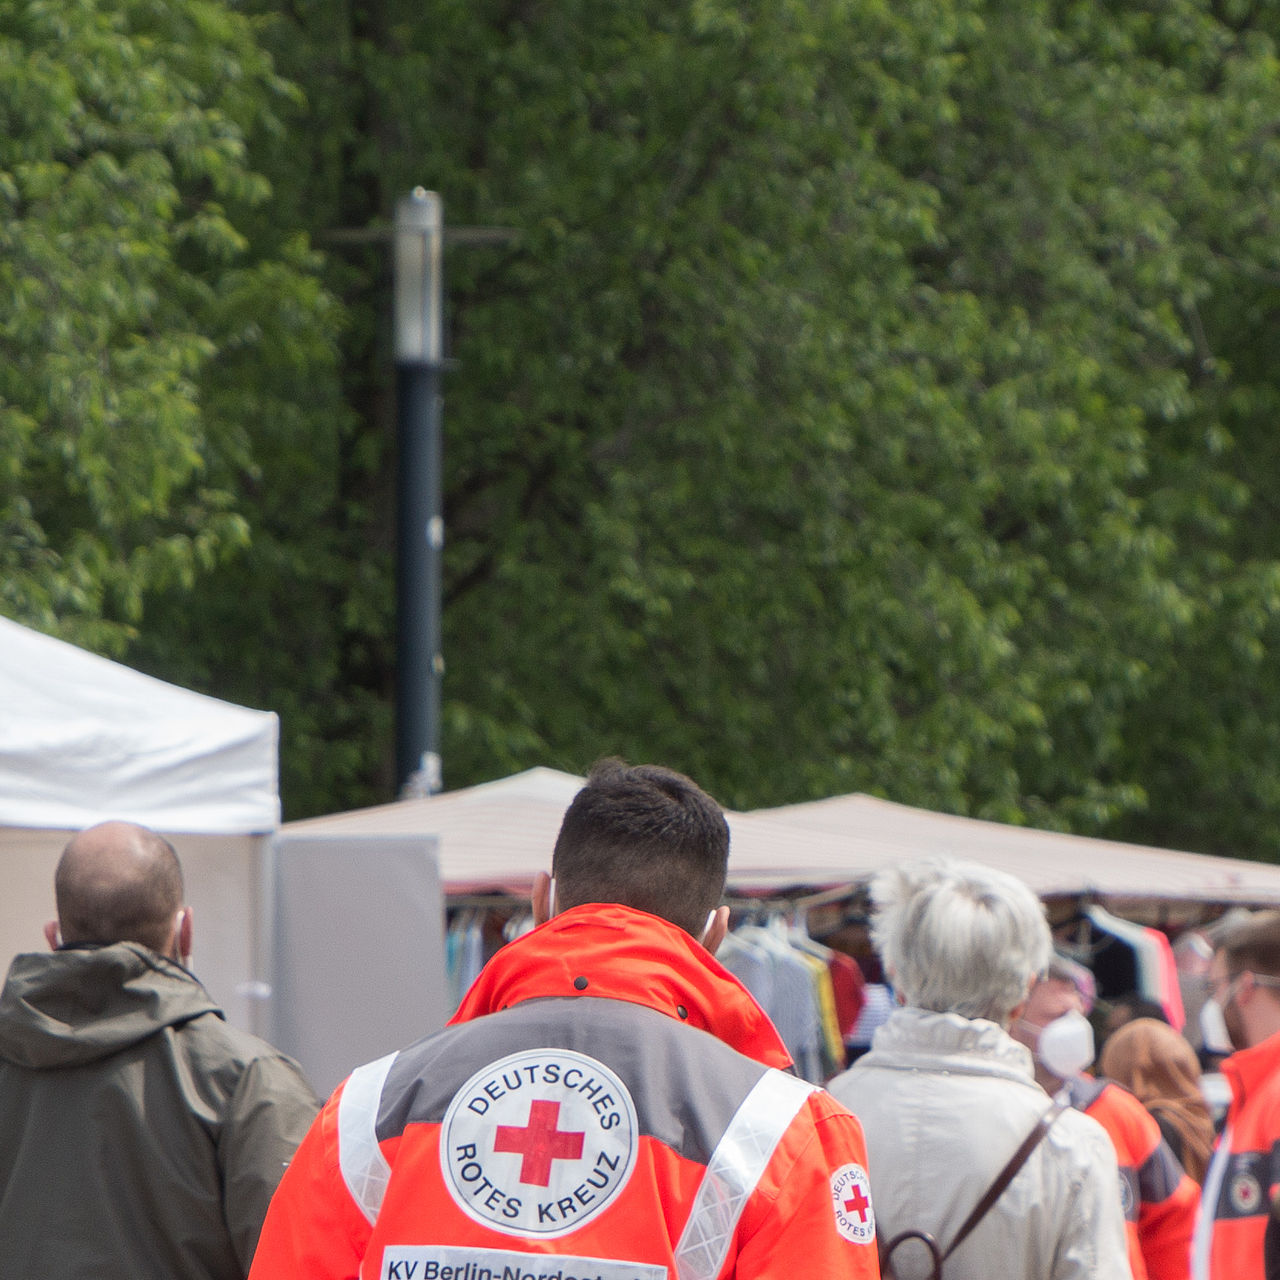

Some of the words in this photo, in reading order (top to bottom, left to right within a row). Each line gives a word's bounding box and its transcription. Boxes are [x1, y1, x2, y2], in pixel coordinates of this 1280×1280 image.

[468, 1064, 621, 1130] DEUTSCHES
[456, 1143, 522, 1218] ROTES
[537, 1151, 620, 1223] KREUZ
[836, 1210, 865, 1237] ROTES
[388, 1261, 418, 1280] KV
